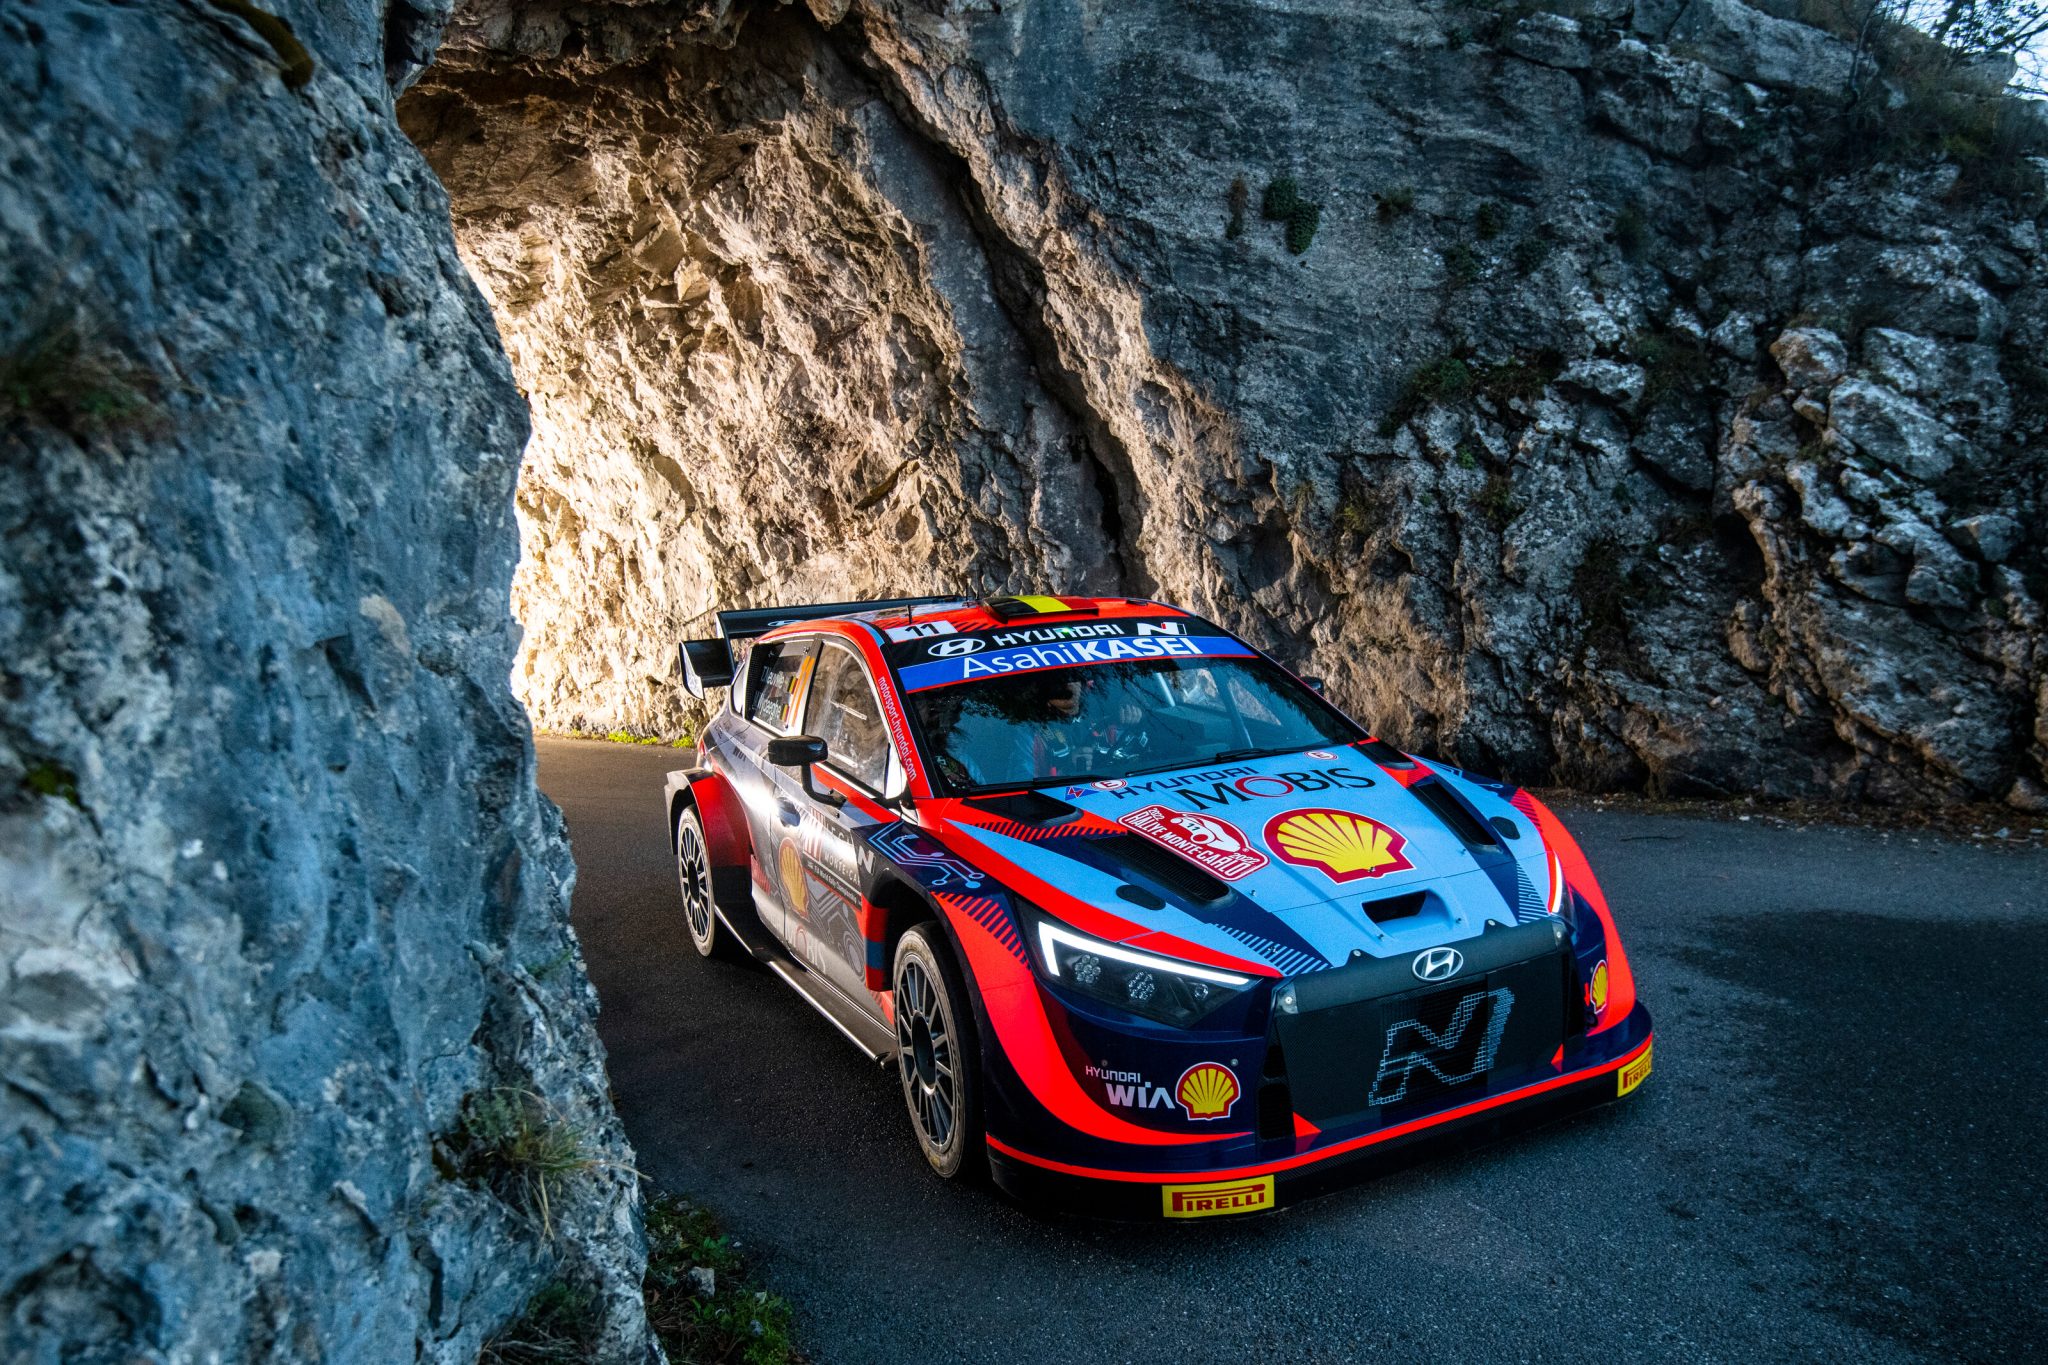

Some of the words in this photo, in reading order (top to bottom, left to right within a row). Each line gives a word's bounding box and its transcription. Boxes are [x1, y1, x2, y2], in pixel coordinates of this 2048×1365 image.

[905, 622, 941, 637] 11
[993, 624, 1125, 646] HYUNDAI
[963, 637, 1203, 679] AsahiKASEI
[878, 676, 917, 782] motorsport.hyundai.com
[1110, 766, 1259, 799] HYUNDAI
[1174, 767, 1376, 810] MOBIS
[1149, 807, 1166, 821] 2022
[1187, 823, 1201, 832] 11
[1125, 811, 1164, 836] RALLYE
[1161, 832, 1251, 877] MONTE-CARLO
[1229, 852, 1261, 865] 2022
[1085, 1065, 1141, 1083] HYUNDAI
[1172, 1183, 1266, 1212] PIRELLI
